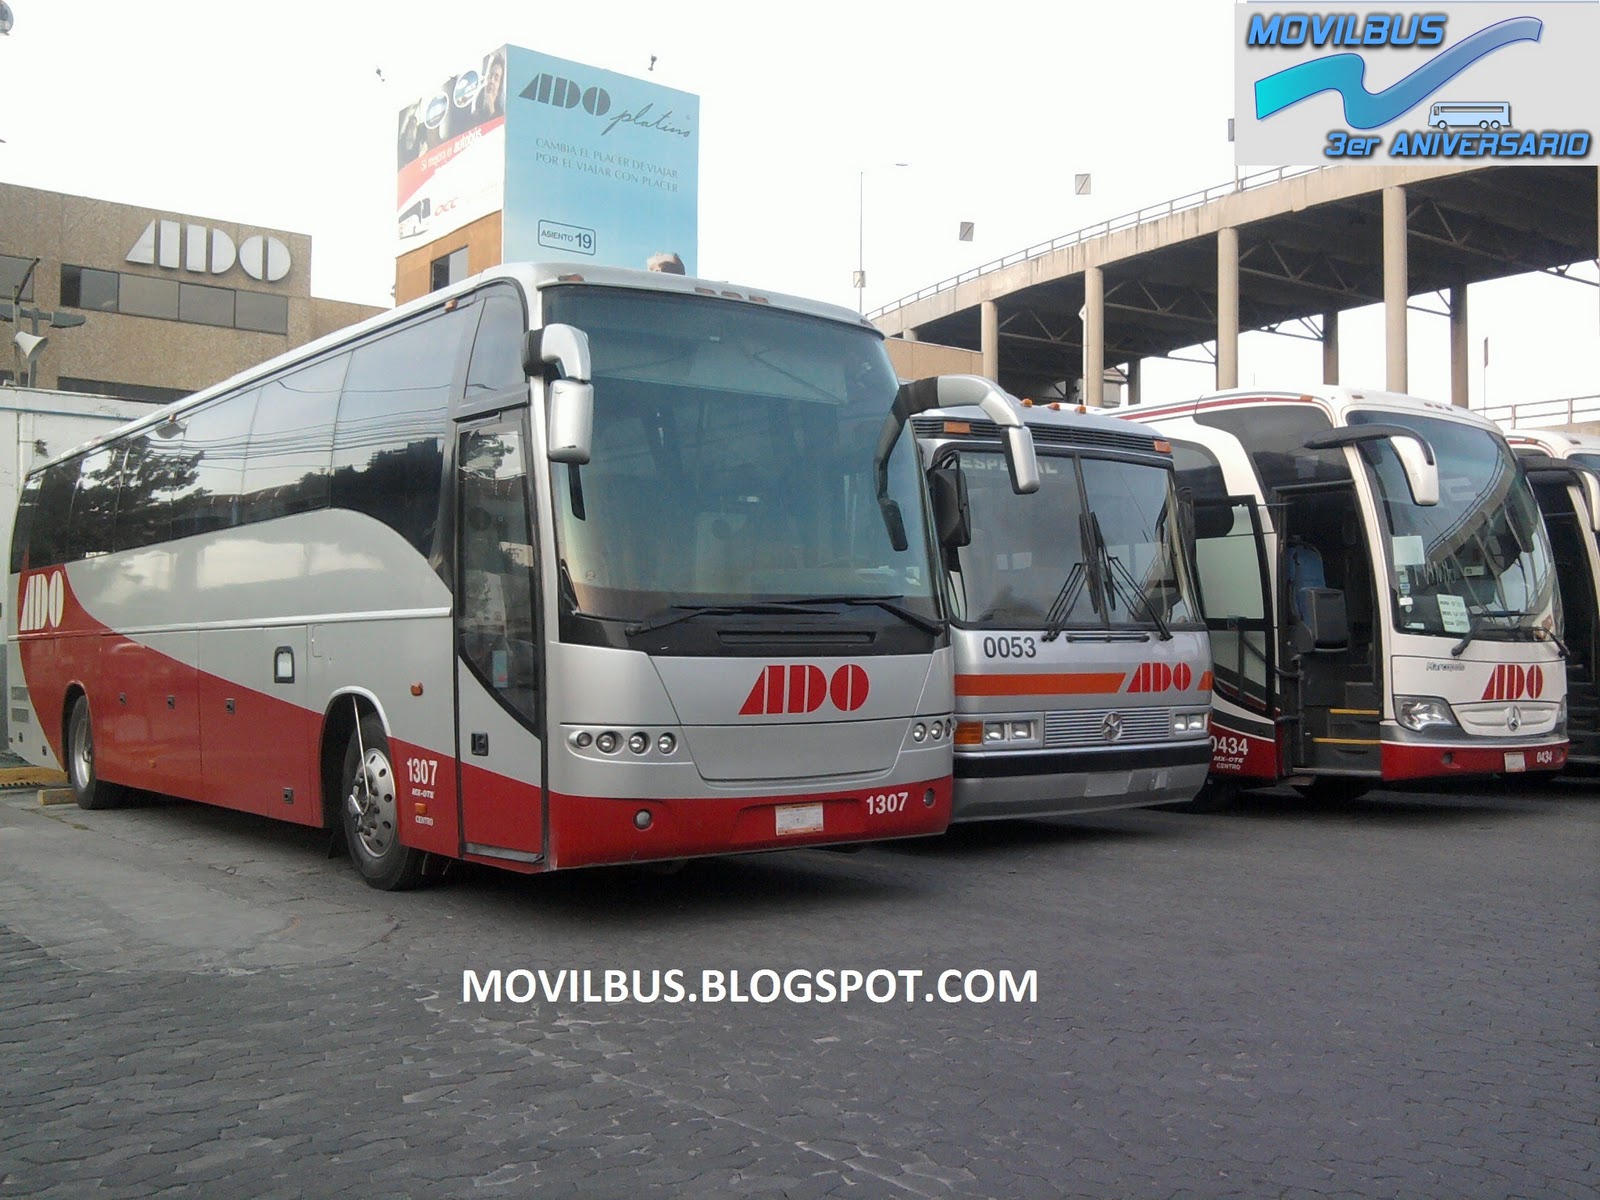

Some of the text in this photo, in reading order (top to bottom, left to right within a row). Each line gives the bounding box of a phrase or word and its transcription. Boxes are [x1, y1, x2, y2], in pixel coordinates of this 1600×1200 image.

[518, 73, 691, 137] ADO platino
[535, 137, 679, 179] CAMBIA EL PLACER DE VIAJAR
[535, 152, 679, 193] POR EL VIAJAR CON PLACER
[125, 219, 292, 282] ADO
[541, 230, 592, 249] ASIENTO 19
[20, 570, 64, 631] ADO
[983, 636, 1037, 659] 0053
[738, 663, 870, 715] ADO
[1126, 662, 1192, 693] ADO
[1481, 664, 1544, 700] ADO
[406, 758, 438, 786] 1307
[1536, 751, 1553, 763] 0434
[866, 792, 909, 815] 1307
